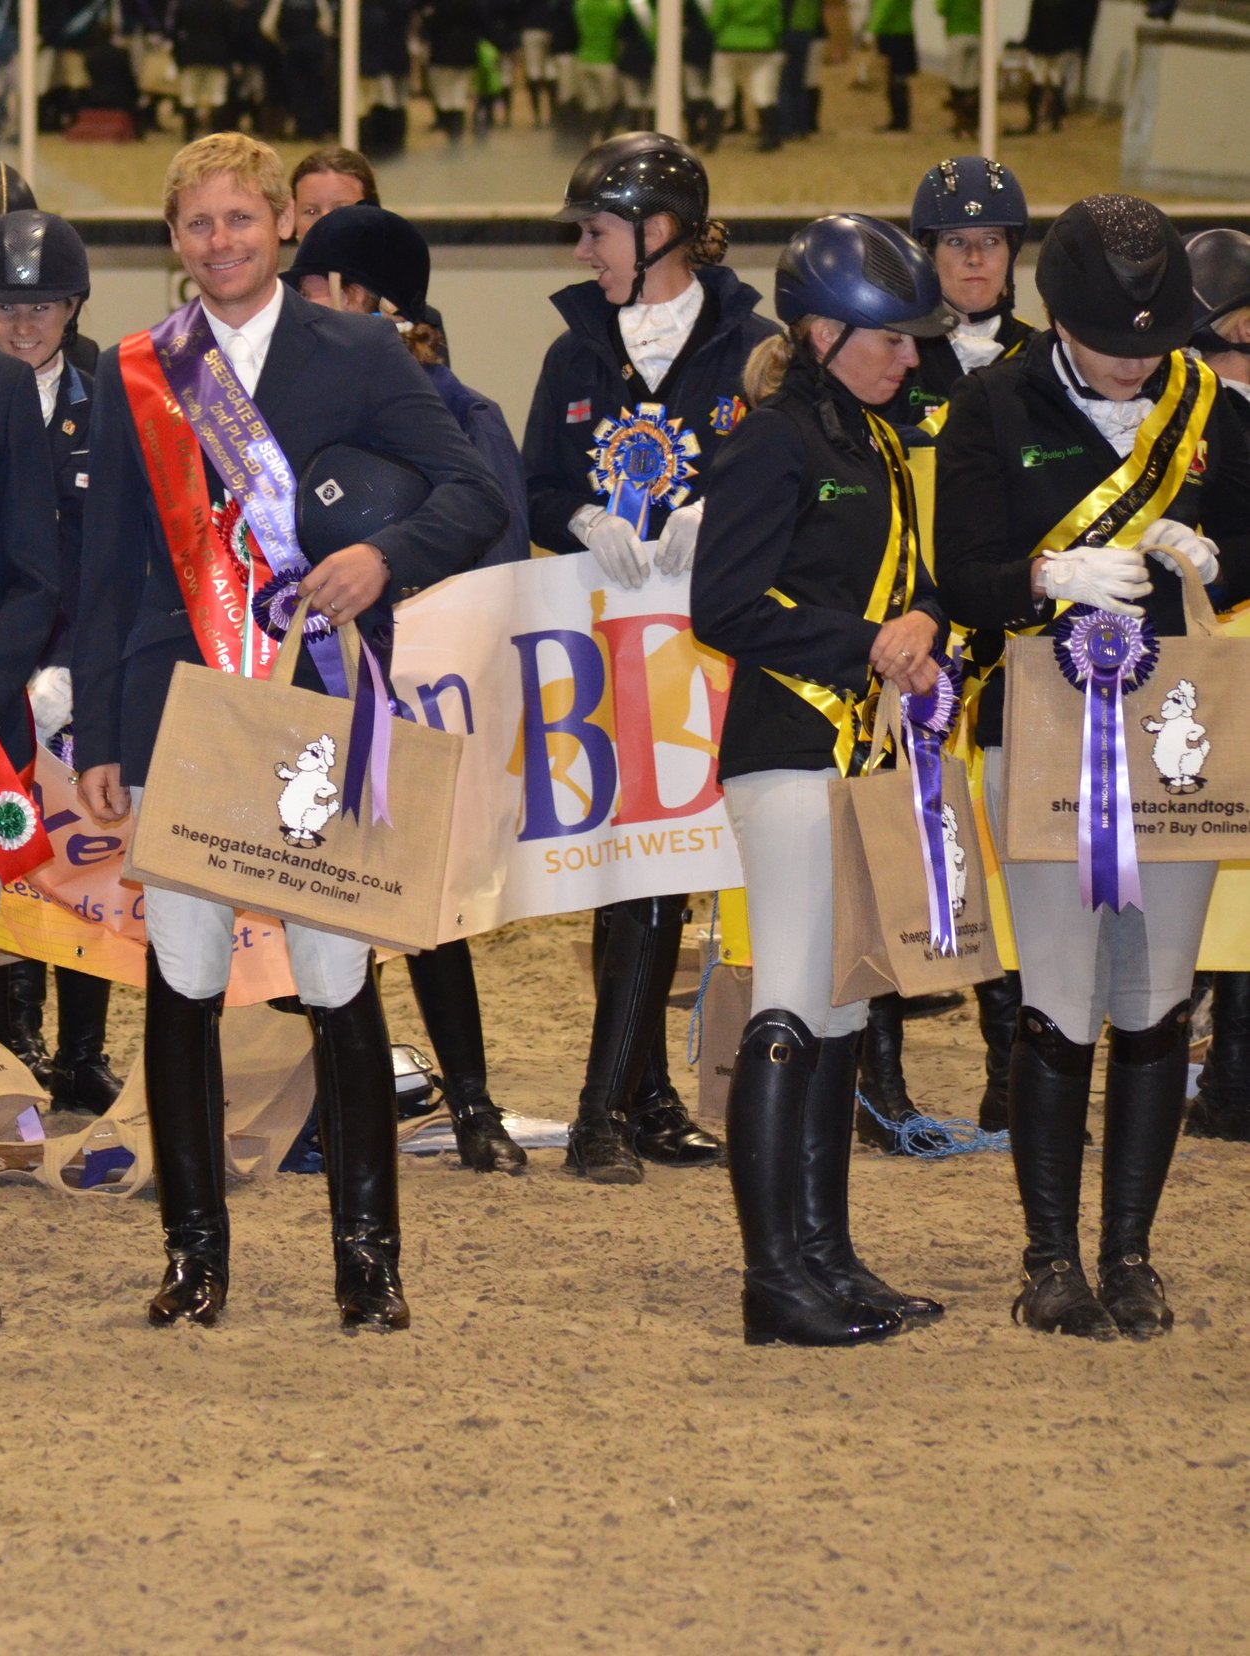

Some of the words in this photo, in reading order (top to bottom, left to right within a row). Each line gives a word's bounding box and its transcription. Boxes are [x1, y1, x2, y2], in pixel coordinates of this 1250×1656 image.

[204, 348, 256, 423] SHEEPGATE
[246, 420, 267, 441] BD
[259, 440, 293, 493] SENIOR
[209, 401, 234, 426] 2nd
[224, 423, 263, 475] PLACED
[244, 491, 288, 562] SHEEPGATE
[1101, 753, 1109, 810] INTERNATIONAL
[171, 823, 403, 896] sheepgatetackandtogs.co.uk
[544, 835, 631, 874] SOUTH
[637, 826, 724, 857] WEST
[1170, 821, 1198, 837] Buy
[207, 853, 228, 870] No
[232, 859, 275, 881] Time?
[278, 871, 307, 891] Buy
[310, 880, 361, 904] Online!
